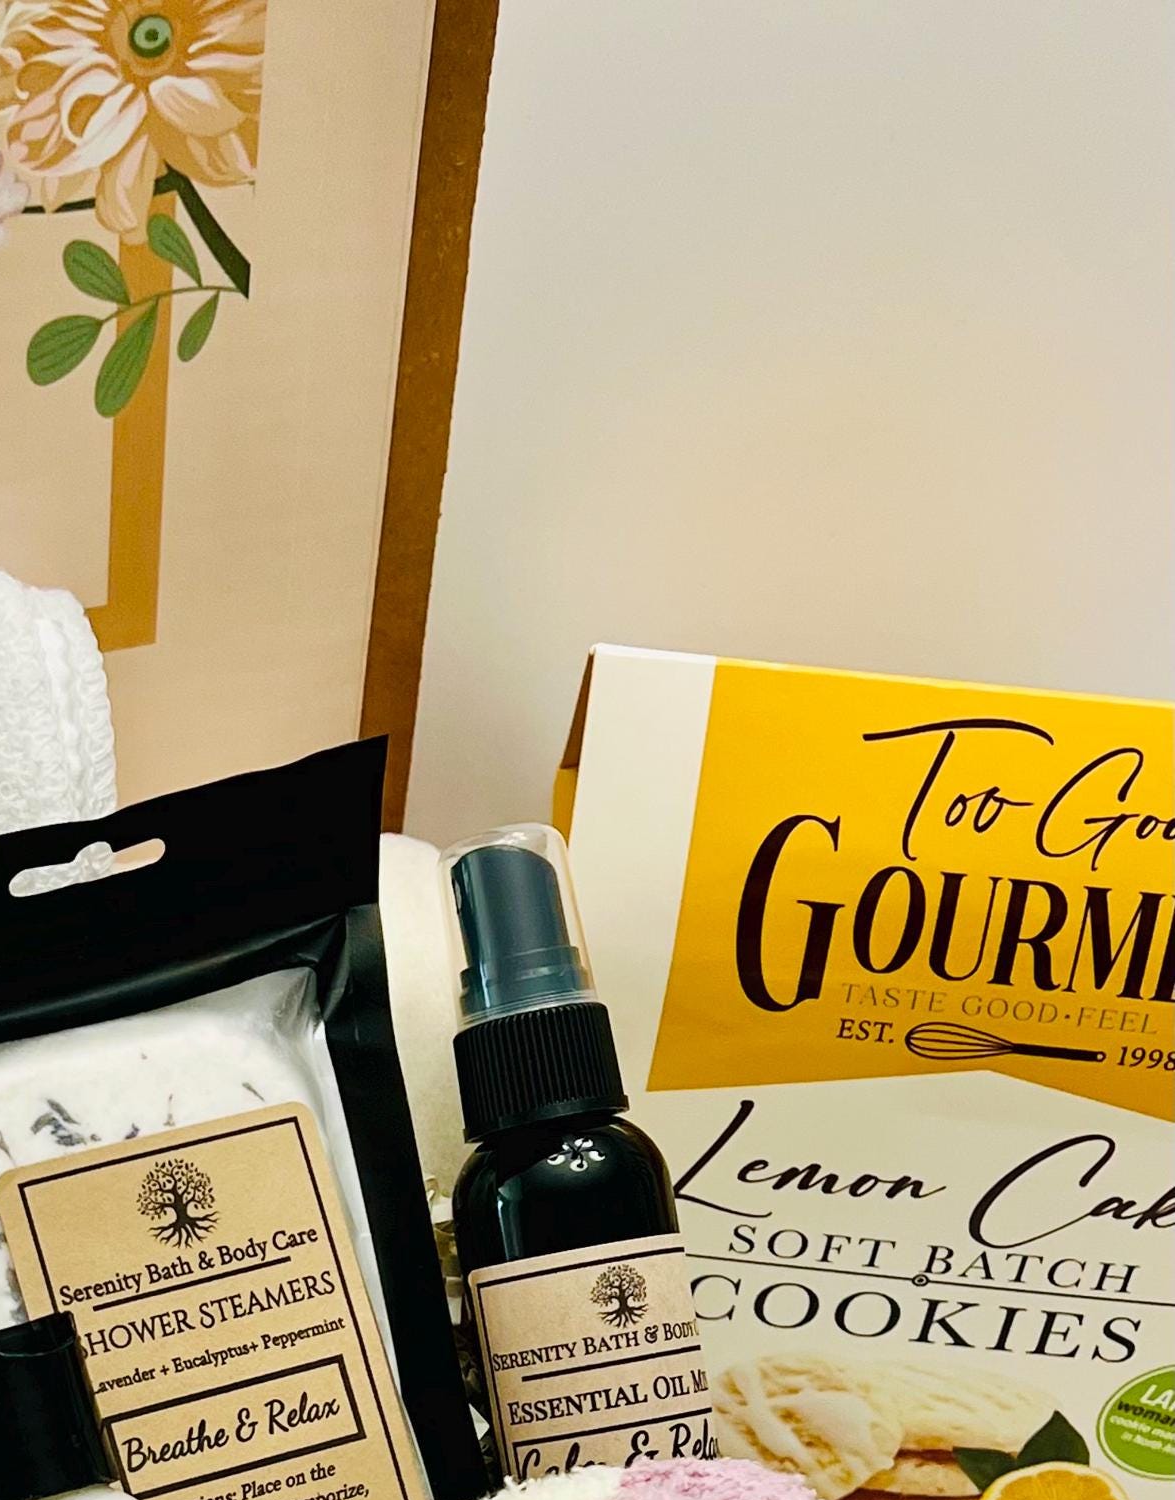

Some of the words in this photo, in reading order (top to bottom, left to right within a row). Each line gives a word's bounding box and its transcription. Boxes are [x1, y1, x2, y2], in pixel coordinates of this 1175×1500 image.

[863, 718, 1054, 861] Too
[1036, 747, 1175, 872] Goo
[736, 814, 1175, 1012] GOURM
[841, 983, 948, 1014] TASTE
[836, 1018, 894, 1044] EST.
[1117, 1045, 1175, 1071] 1998
[674, 1099, 946, 1218] Lemon
[968, 1133, 1175, 1249] Cak
[60, 1273, 142, 1306] Serenity
[145, 1256, 194, 1285] Bath
[198, 1251, 215, 1270] &
[217, 1238, 267, 1265] Body
[272, 1228, 319, 1251] Care
[728, 1223, 895, 1270] SOFT
[923, 1244, 1139, 1294] BATCH
[199, 1271, 336, 1329] STEAMERS
[692, 1274, 1143, 1363] COOKIES
[261, 1317, 346, 1349] Peppermint
[493, 1341, 576, 1371] SERENITY
[582, 1331, 638, 1355] BATH
[508, 1384, 648, 1426] ESSENTIAL
[653, 1374, 689, 1400] OIL
[121, 1419, 230, 1473] Breathe
[265, 1392, 340, 1435] Relax
[285, 1473, 306, 1487] on
[310, 1463, 336, 1481] the
